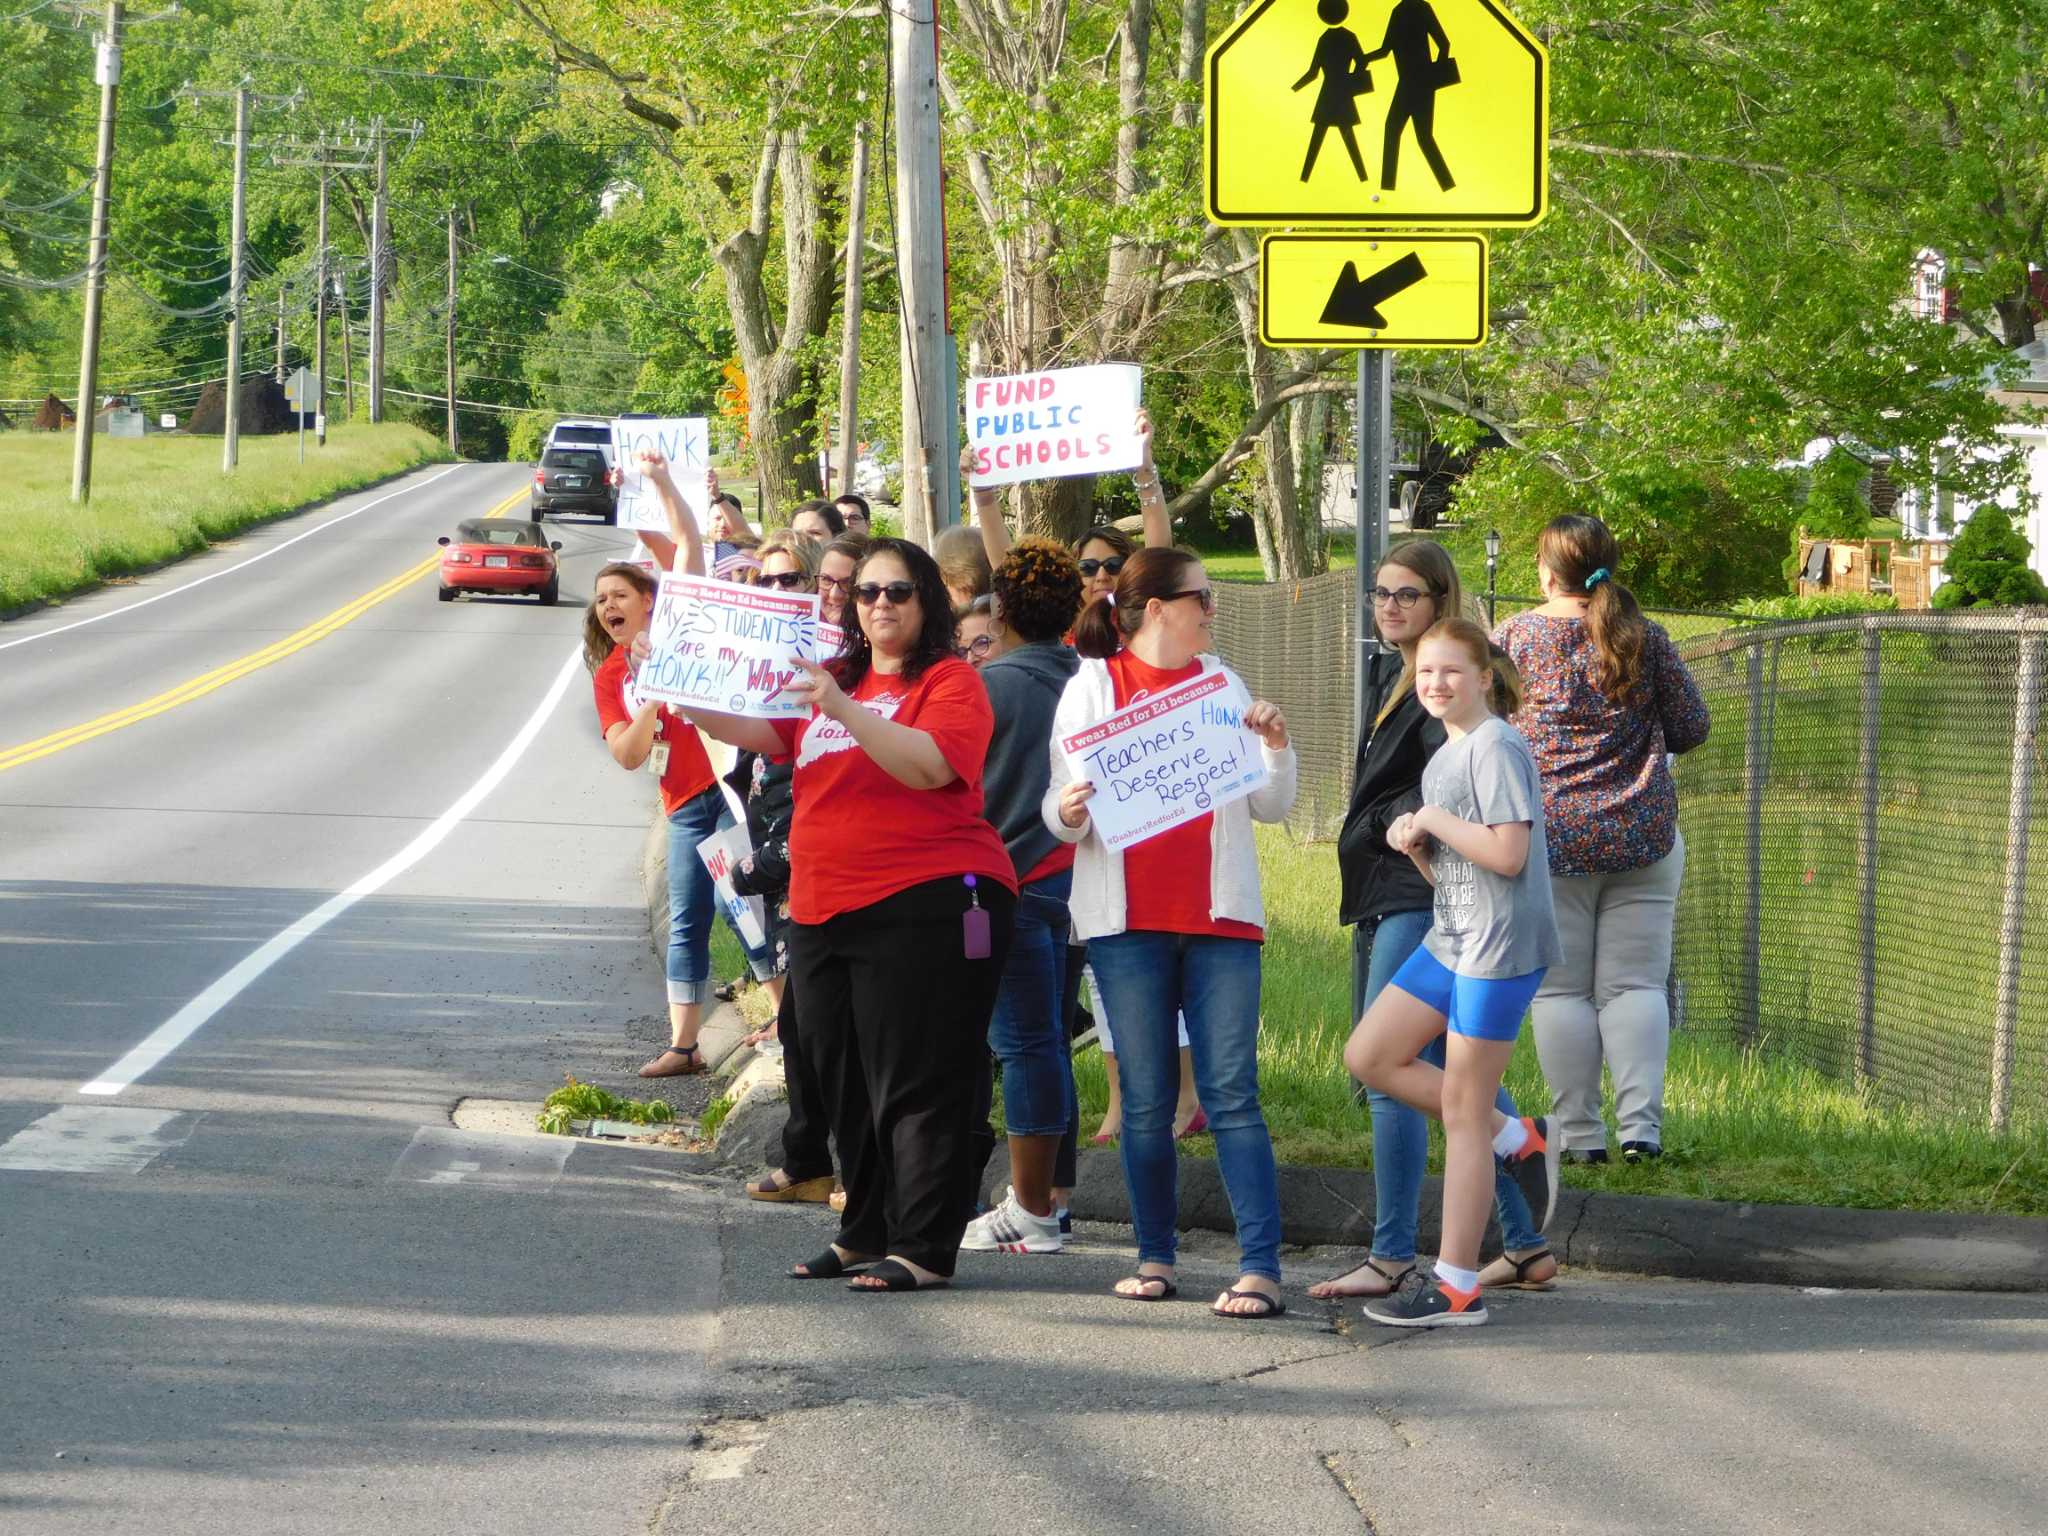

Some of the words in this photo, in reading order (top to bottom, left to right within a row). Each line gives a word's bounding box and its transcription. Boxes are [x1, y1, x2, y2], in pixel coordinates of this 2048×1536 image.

[976, 377, 1055, 409] FUND
[976, 405, 1083, 439] PUBLIC
[975, 433, 1113, 476] SCHOOLS
[700, 586, 721, 600] Red
[721, 591, 737, 603] for
[737, 593, 751, 606] Ed
[657, 597, 685, 640] My
[692, 603, 800, 644] STUDENTS
[674, 640, 705, 659] are
[718, 647, 744, 677] my
[1065, 740, 1074, 752] I
[1074, 729, 1106, 747] wear
[1107, 715, 1131, 734] Red
[1133, 710, 1151, 723] for
[1151, 701, 1169, 715] Ed
[1084, 720, 1195, 778] Teachers
[1110, 747, 1210, 802] Deserve
[1446, 862, 1474, 882] THAT
